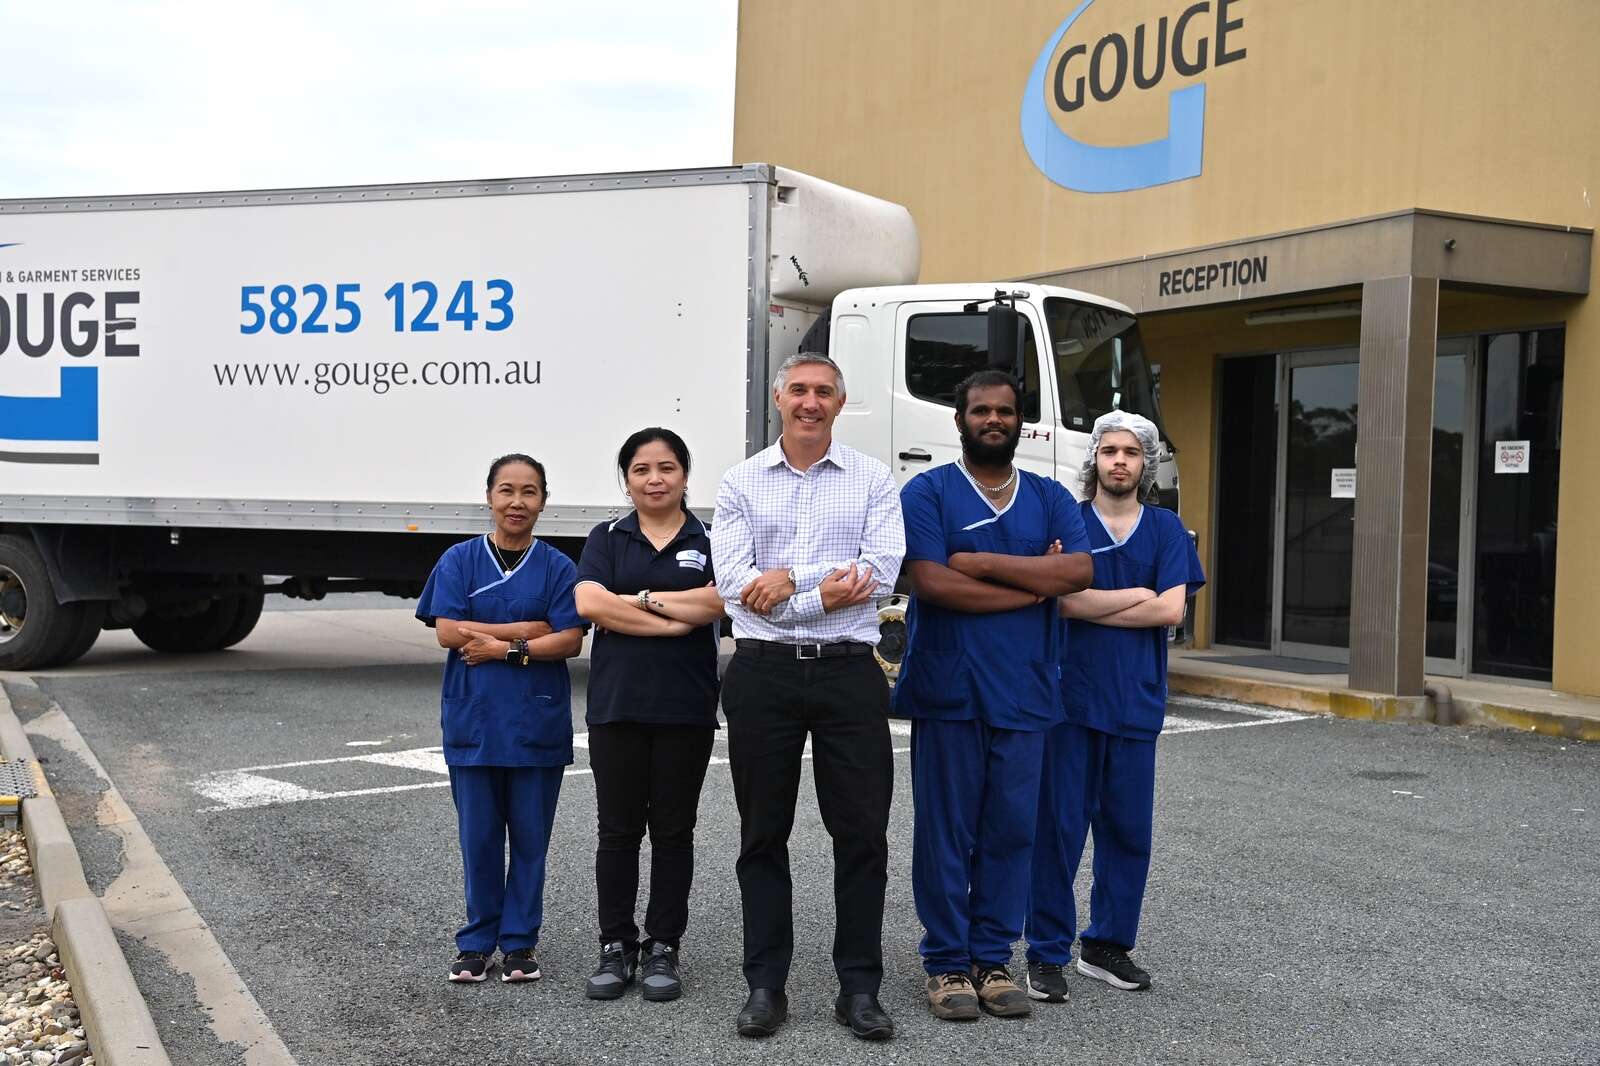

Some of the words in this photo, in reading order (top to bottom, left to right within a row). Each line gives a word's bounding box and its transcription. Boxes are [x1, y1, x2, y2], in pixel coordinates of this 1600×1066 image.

[1054, 0, 1248, 112] GOUGE
[6, 271, 14, 283] &
[18, 269, 78, 283] GARMENT
[81, 268, 141, 282] SERVICES
[1159, 255, 1268, 297] RECEPTION
[0, 291, 140, 358] UGE
[240, 283, 362, 335] 5825
[384, 278, 514, 333] 1243
[213, 359, 541, 395] www.gouge.com.au
